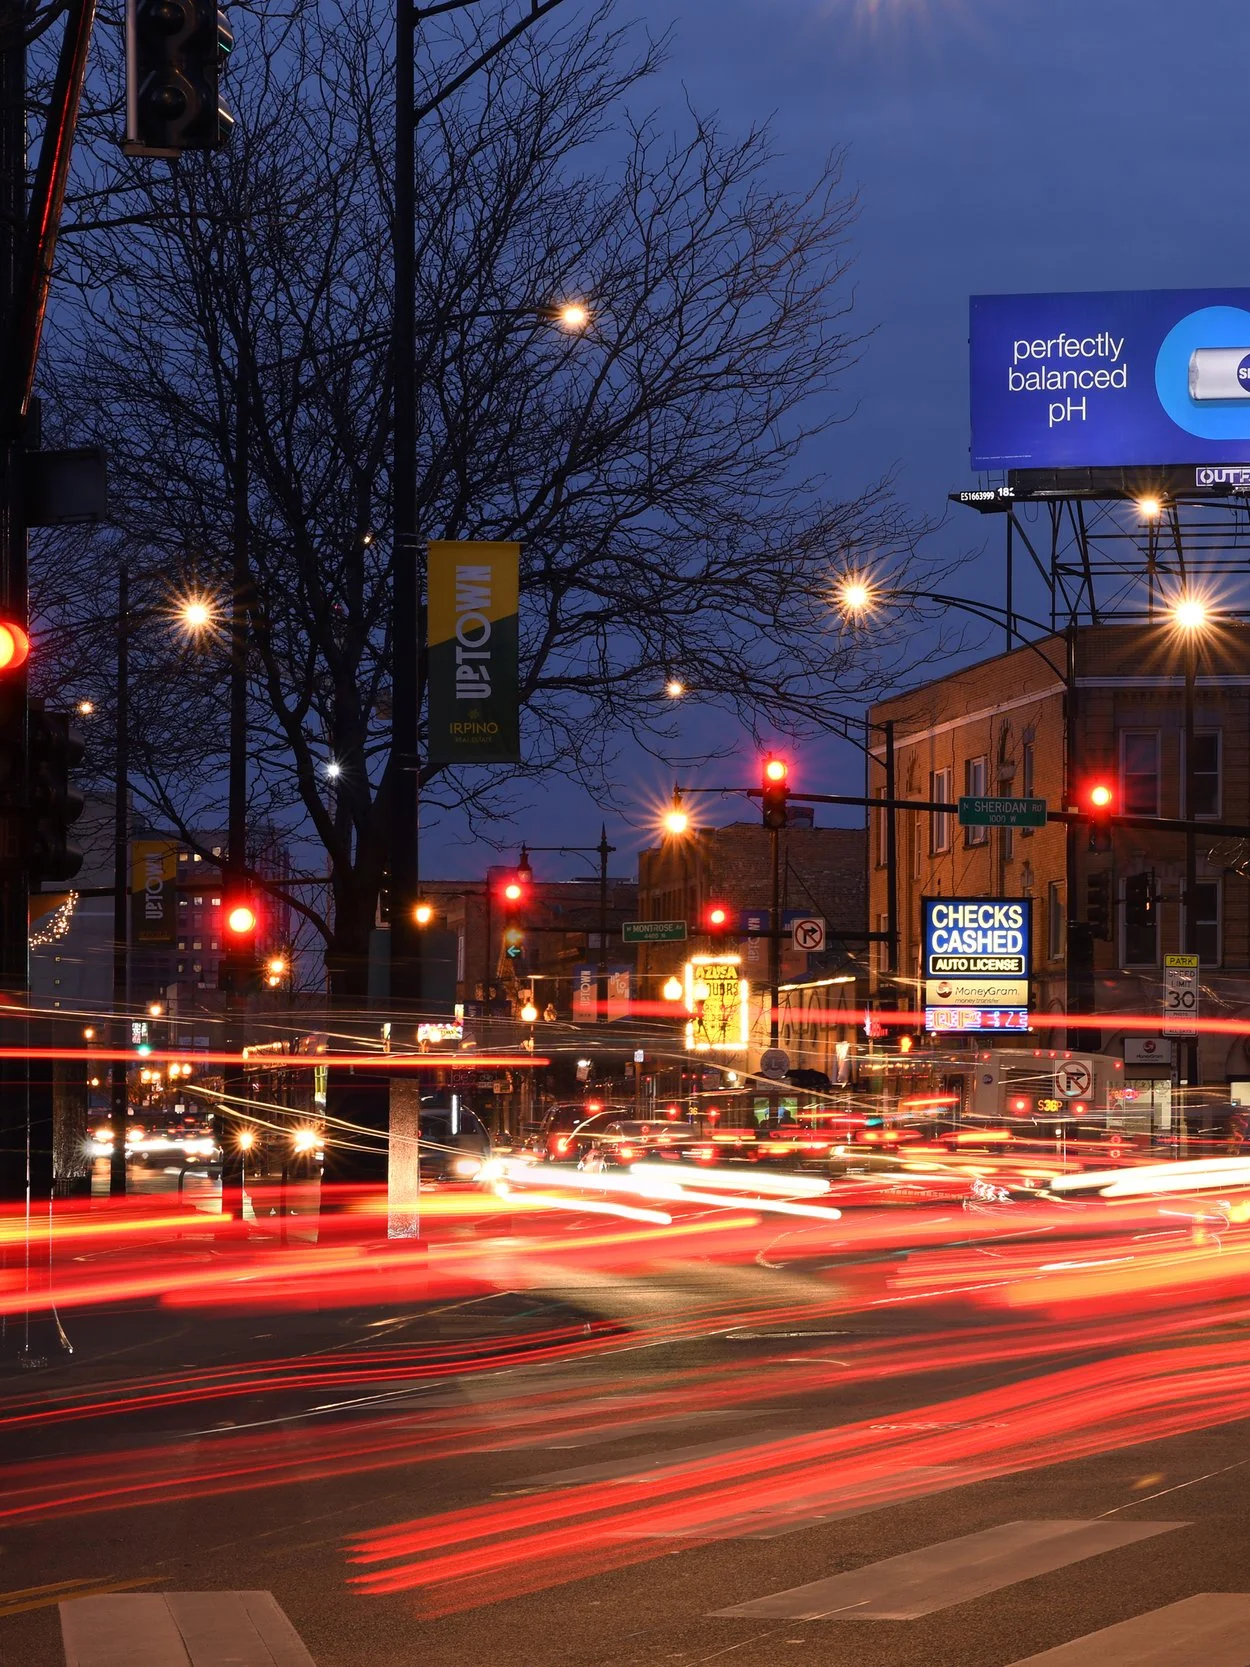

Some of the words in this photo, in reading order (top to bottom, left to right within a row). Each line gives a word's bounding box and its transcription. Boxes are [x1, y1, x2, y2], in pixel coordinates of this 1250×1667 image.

[1014, 332, 1124, 365] perfectly
[1009, 364, 1127, 391] balanced
[1049, 397, 1086, 428] pH
[455, 565, 492, 700] UPTOWN
[450, 722, 498, 734] IRPINO
[974, 801, 1027, 813] SHERIDAN
[931, 905, 1023, 929] CHECKS
[632, 924, 674, 933] MONTROSE
[931, 930, 1023, 954] CASHED
[935, 959, 967, 971] AUTO
[969, 959, 1019, 971] LICENSE
[1169, 958, 1194, 966] PARK
[695, 966, 738, 979] AZUSA
[1168, 991, 1195, 1009] 30
